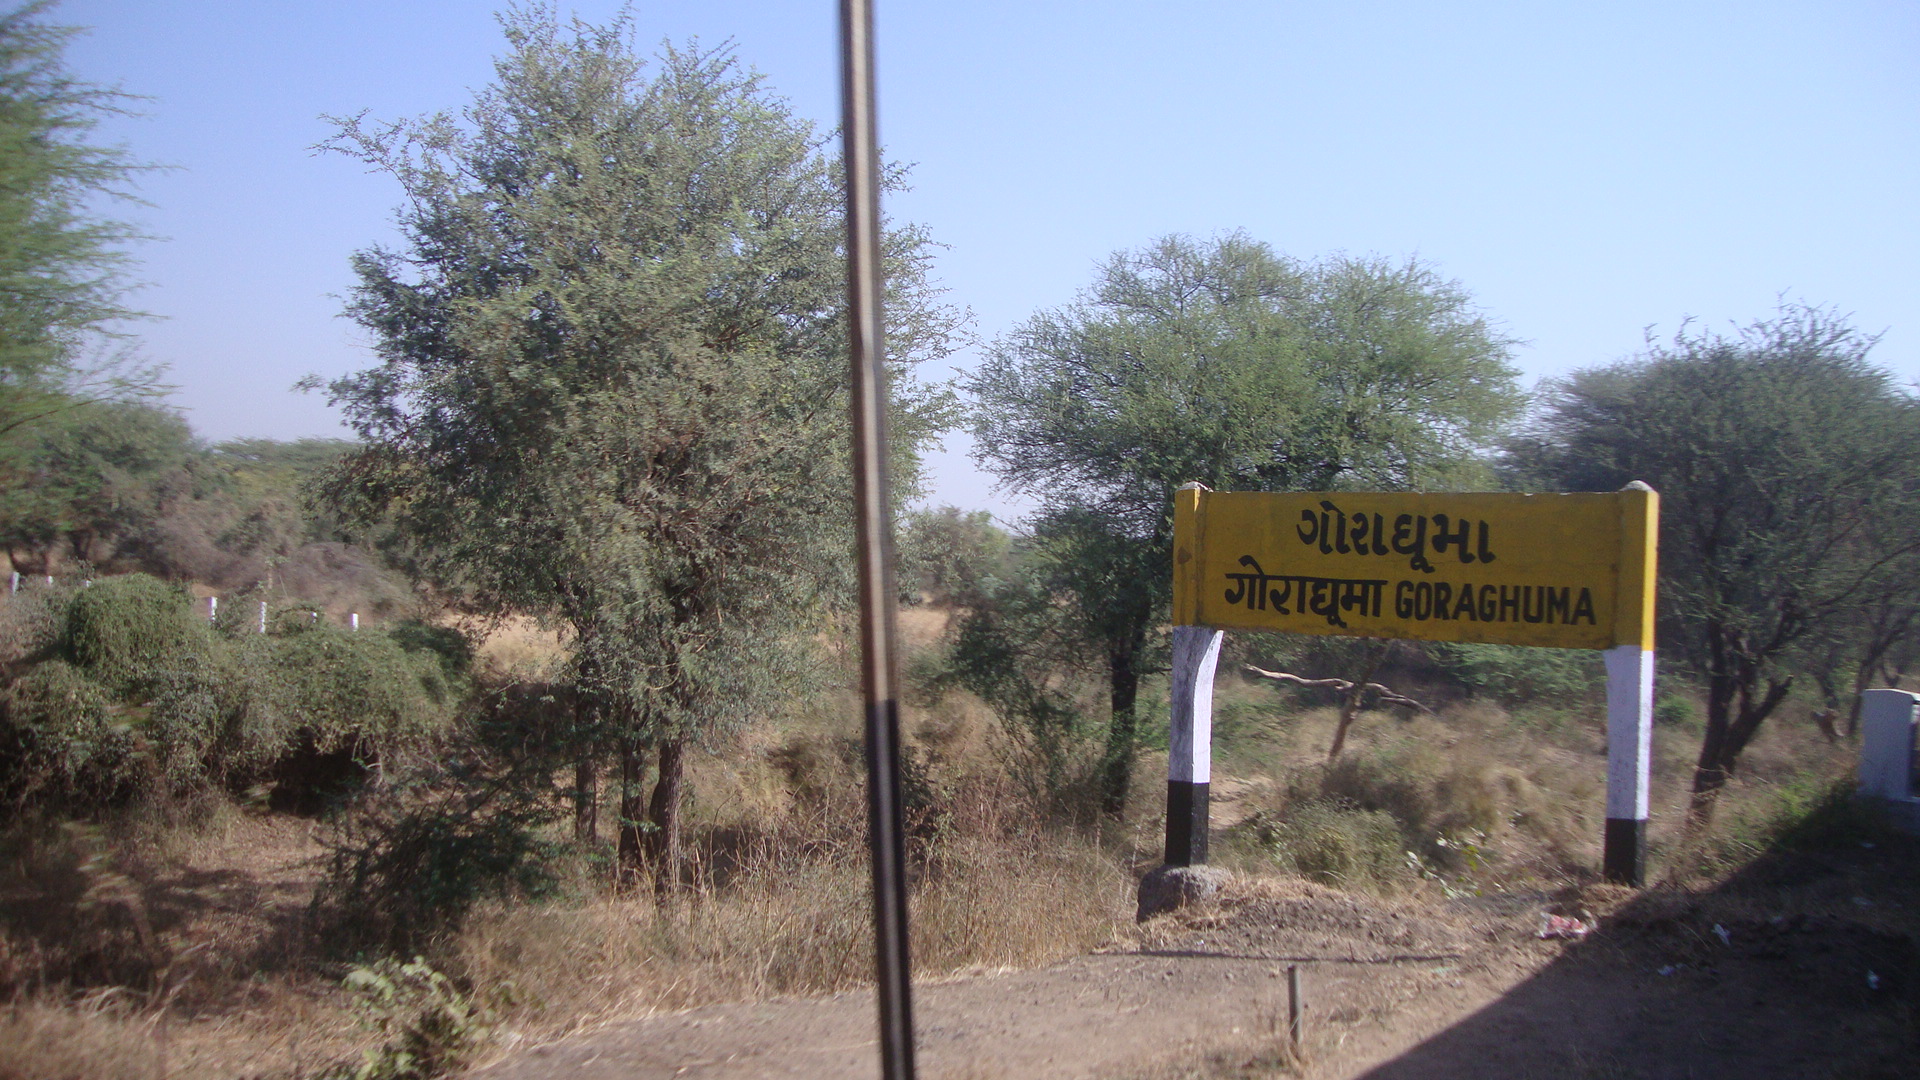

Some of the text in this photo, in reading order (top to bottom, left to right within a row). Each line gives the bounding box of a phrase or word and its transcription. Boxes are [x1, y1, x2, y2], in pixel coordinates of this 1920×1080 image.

[1297, 501, 1496, 572] ગોરાઘૂમા
[1225, 555, 1388, 628] गोराघूमा
[1396, 580, 1597, 625] GORAGHUMA
